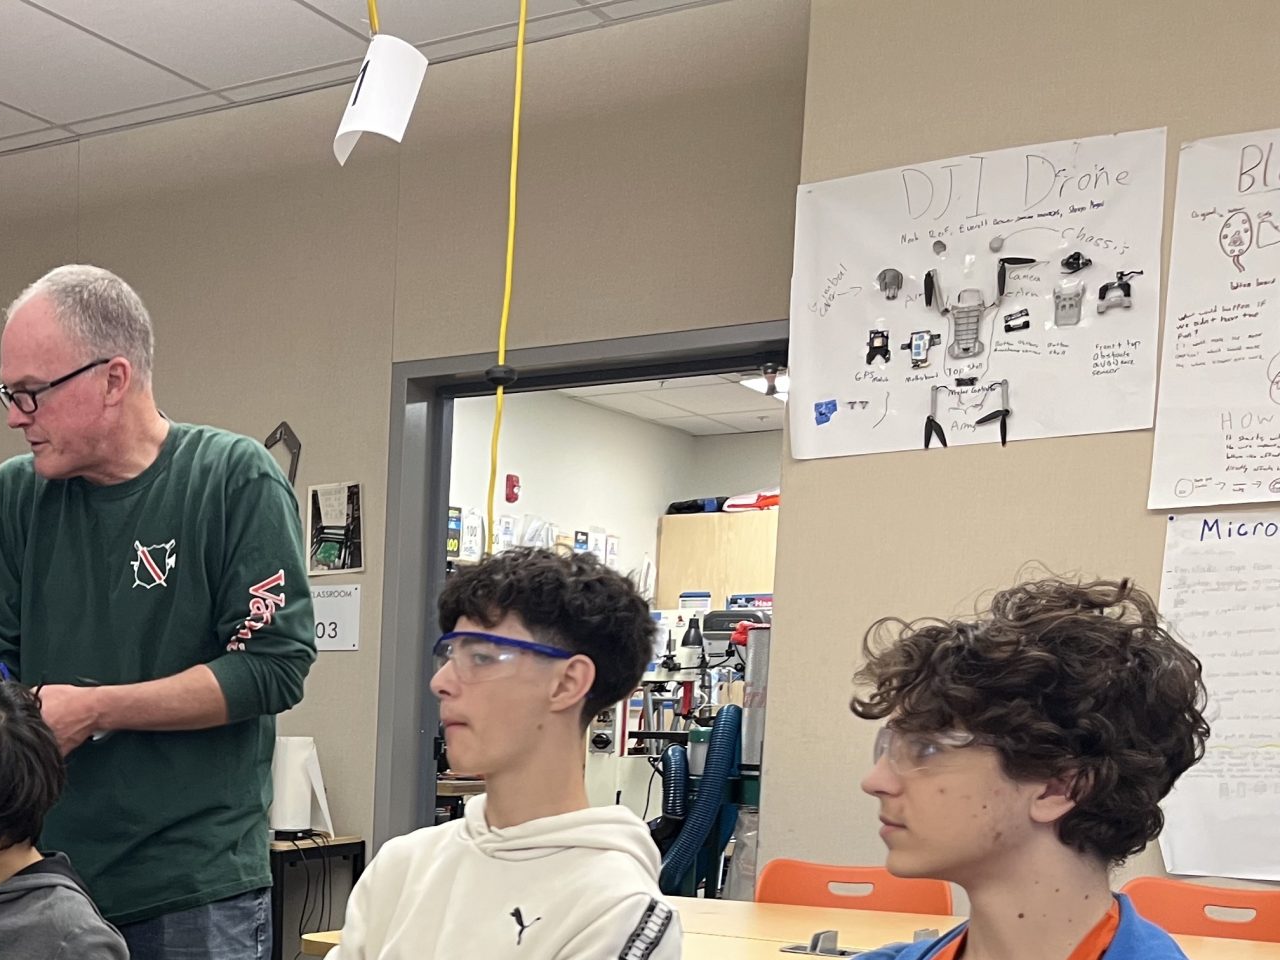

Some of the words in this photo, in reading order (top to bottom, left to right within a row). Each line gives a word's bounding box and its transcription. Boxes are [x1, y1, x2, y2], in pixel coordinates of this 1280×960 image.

[1238, 142, 1280, 193] Bl
[1023, 154, 1130, 212] Drone
[854, 371, 874, 381] GPS
[1200, 518, 1279, 542] Micro
[312, 590, 352, 599] LASSROOM
[315, 621, 338, 639] 03
